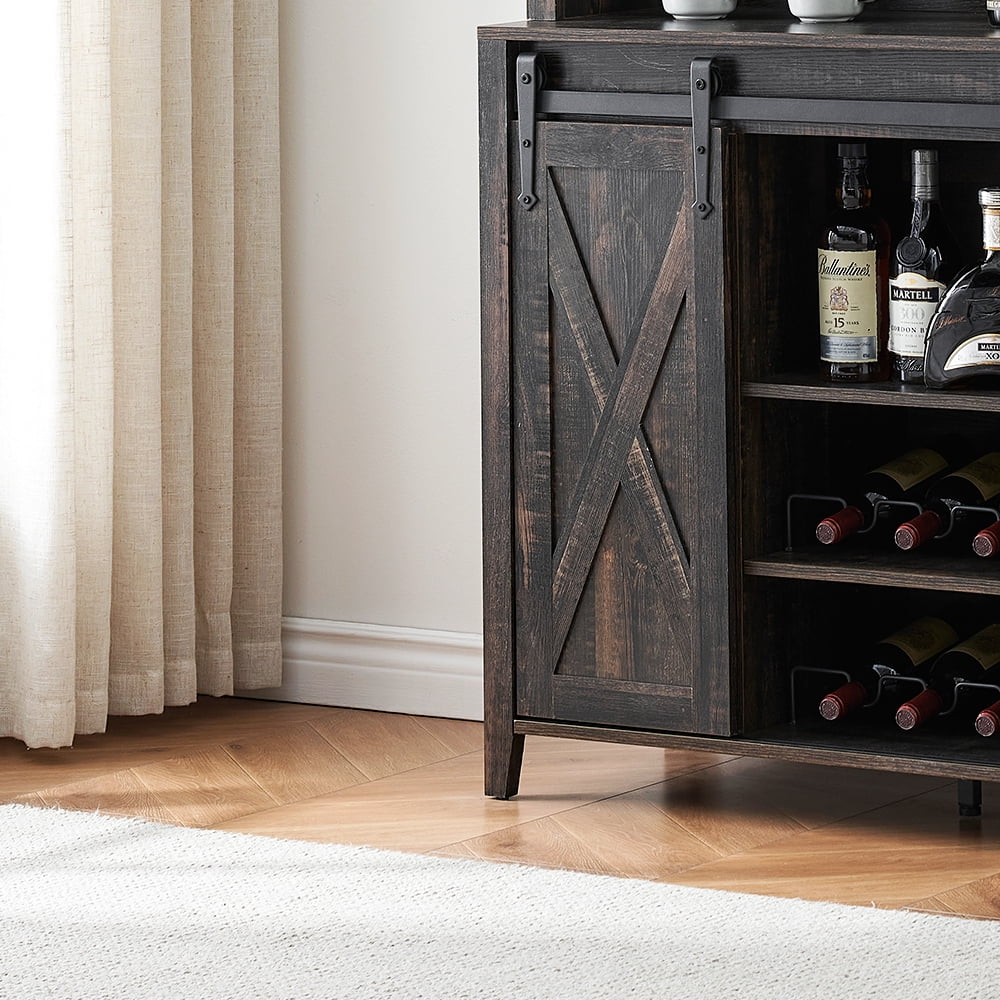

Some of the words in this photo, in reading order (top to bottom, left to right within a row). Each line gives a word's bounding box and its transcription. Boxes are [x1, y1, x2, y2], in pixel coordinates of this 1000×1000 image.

[893, 289, 933, 300] MARTELL
[833, 317, 845, 328] 15
[985, 352, 1000, 360] XO
